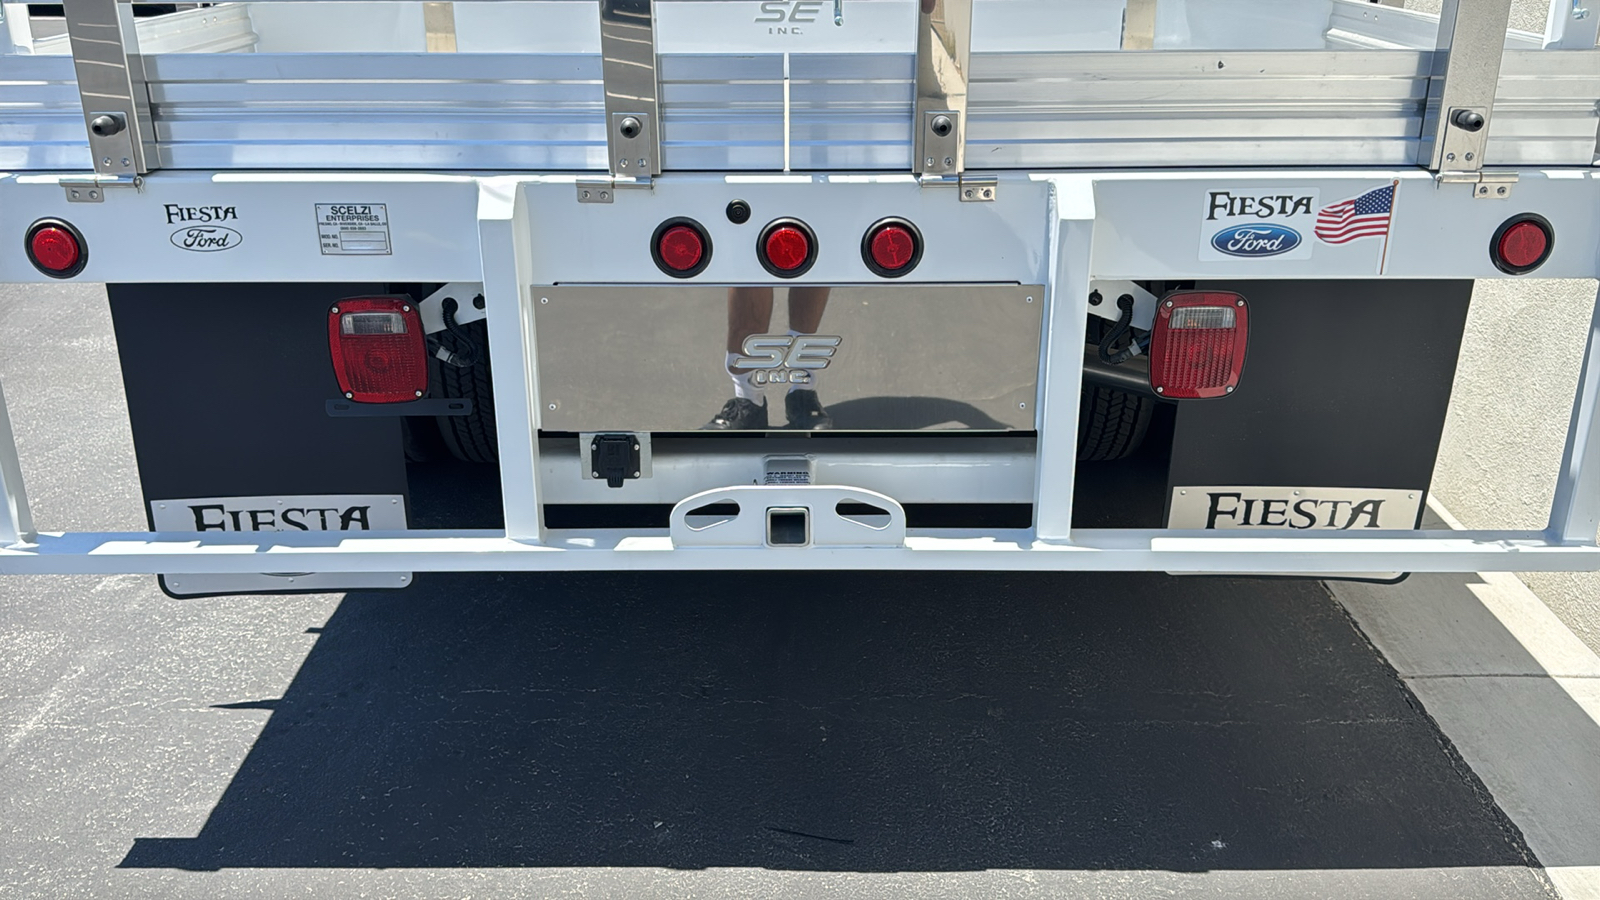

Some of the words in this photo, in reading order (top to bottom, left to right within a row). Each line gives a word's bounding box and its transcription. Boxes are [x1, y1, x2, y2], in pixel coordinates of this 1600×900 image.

[754, 2, 823, 23] SE
[768, 27, 803, 35] INC.
[163, 203, 238, 225] FIESTA
[330, 205, 372, 215] SCELZI
[1206, 191, 1314, 220] FIESTA
[183, 228, 230, 248] Ford
[1227, 229, 1286, 251] Ford
[733, 334, 843, 369] SE
[1205, 492, 1386, 530] FIESTA
